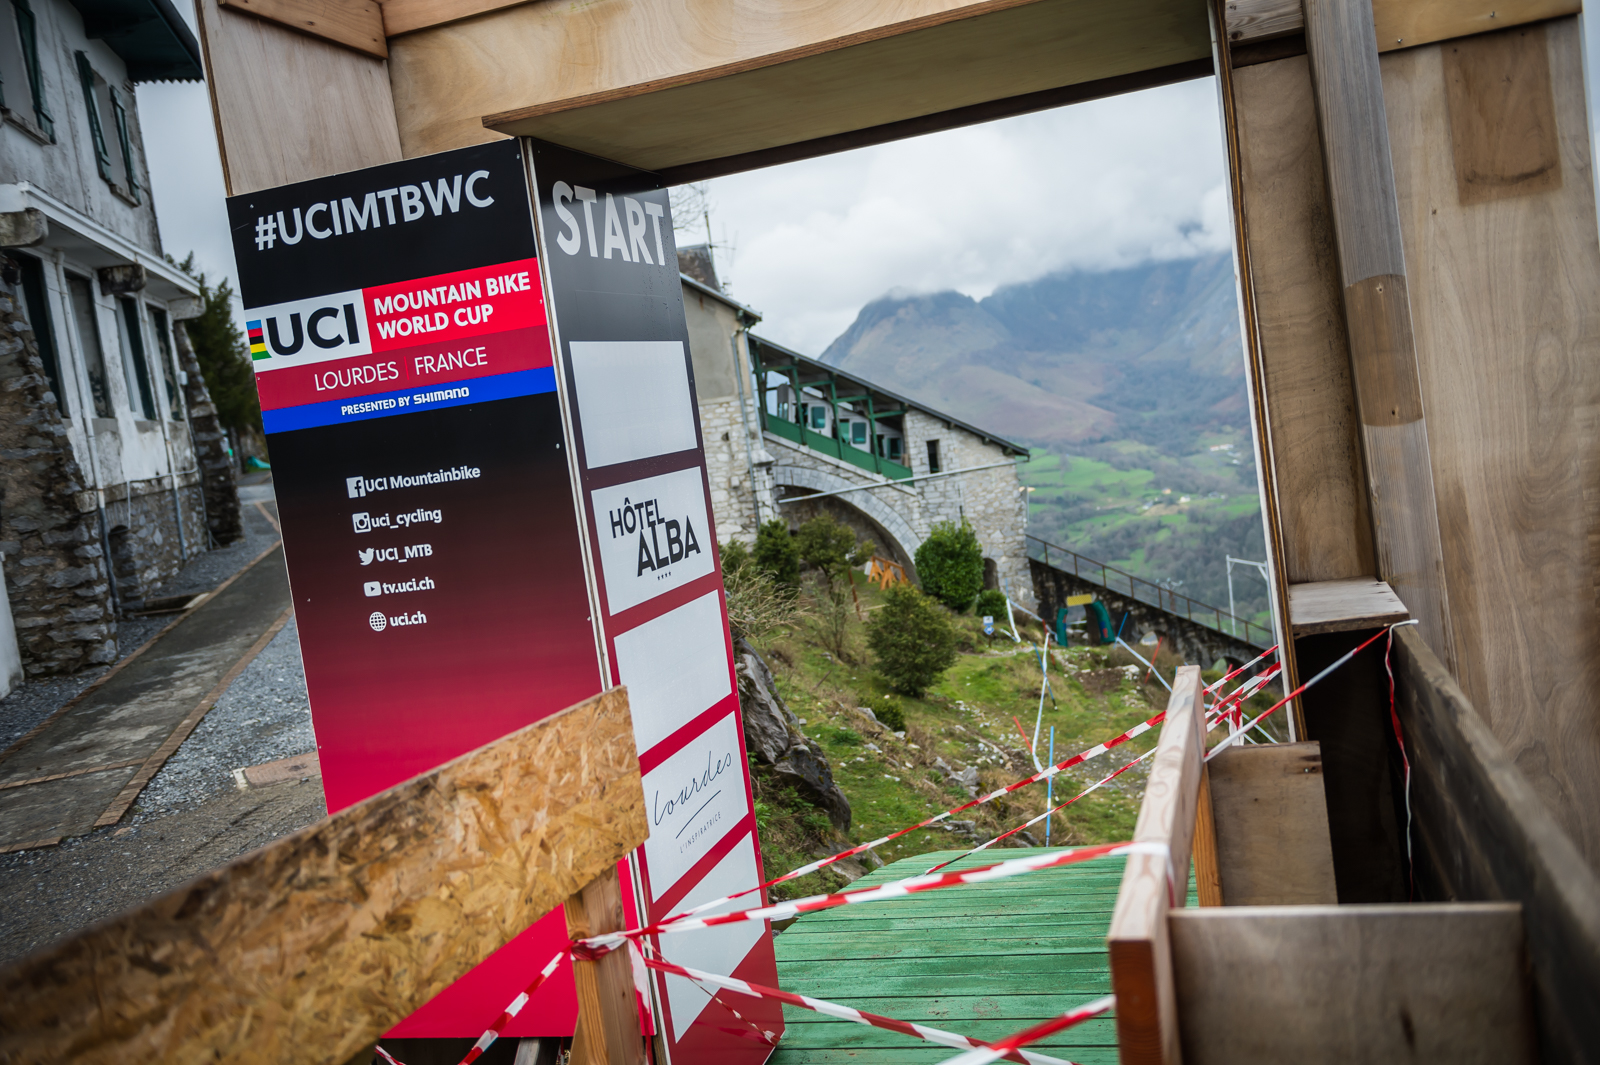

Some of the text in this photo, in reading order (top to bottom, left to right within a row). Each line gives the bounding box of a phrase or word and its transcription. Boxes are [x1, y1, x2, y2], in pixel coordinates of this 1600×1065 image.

[254, 169, 495, 251] #UCIMTBWC
[551, 179, 666, 266] START
[373, 271, 531, 316] MOUNTAIN BIKE
[265, 303, 361, 357] UCI
[376, 304, 494, 340] WORLD CUP
[314, 346, 488, 391] LOURDES FRANCE
[340, 386, 470, 416] PRESENTED BY SHIMANO
[364, 477, 388, 493] UCI
[389, 465, 481, 490] Mountainbike
[371, 508, 443, 528] uci_cycling
[609, 497, 665, 539] HÔTEL
[375, 543, 433, 563] UCI_MTB
[637, 515, 701, 577] ALBA
[382, 576, 435, 595] tv.uci.ch
[389, 611, 427, 627] uci.ch
[680, 811, 722, 854] L'INSPIRATRICE
